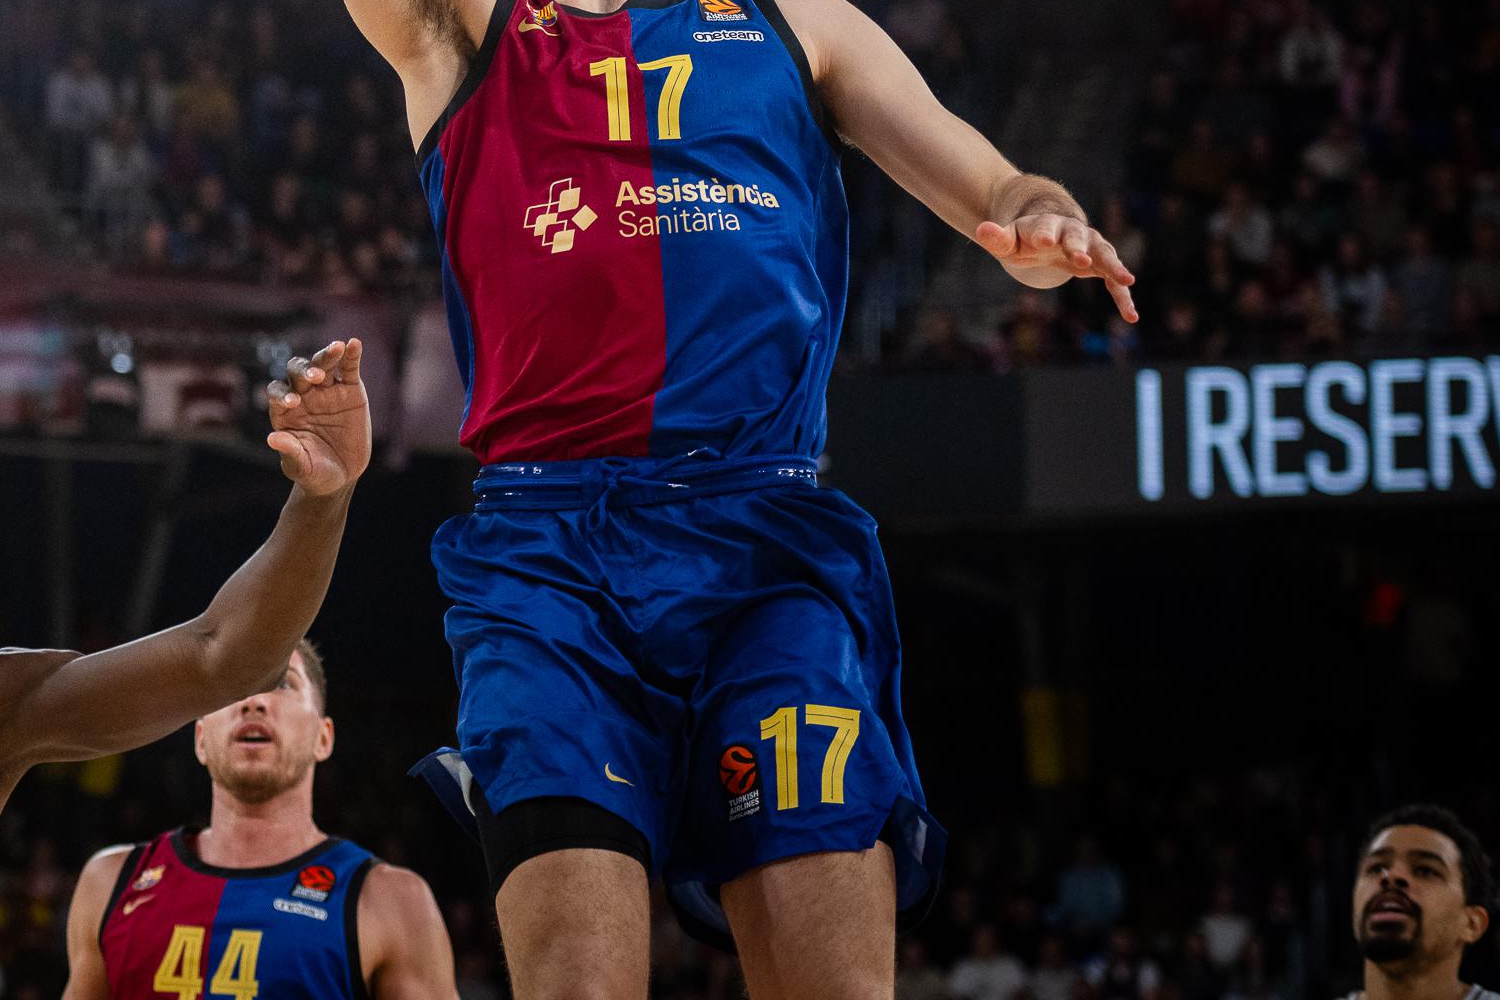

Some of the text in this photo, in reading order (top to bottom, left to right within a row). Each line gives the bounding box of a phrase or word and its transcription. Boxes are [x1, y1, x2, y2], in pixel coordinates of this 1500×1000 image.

[694, 31, 764, 41] oneteam
[590, 54, 693, 141] 17
[615, 177, 780, 208] Assistència
[618, 207, 741, 238] Sanitària
[1135, 368, 1164, 501] I
[760, 703, 861, 811] 17
[729, 789, 759, 807] TURKISH
[729, 797, 760, 814] AIRLINES
[153, 924, 263, 1000] 44
